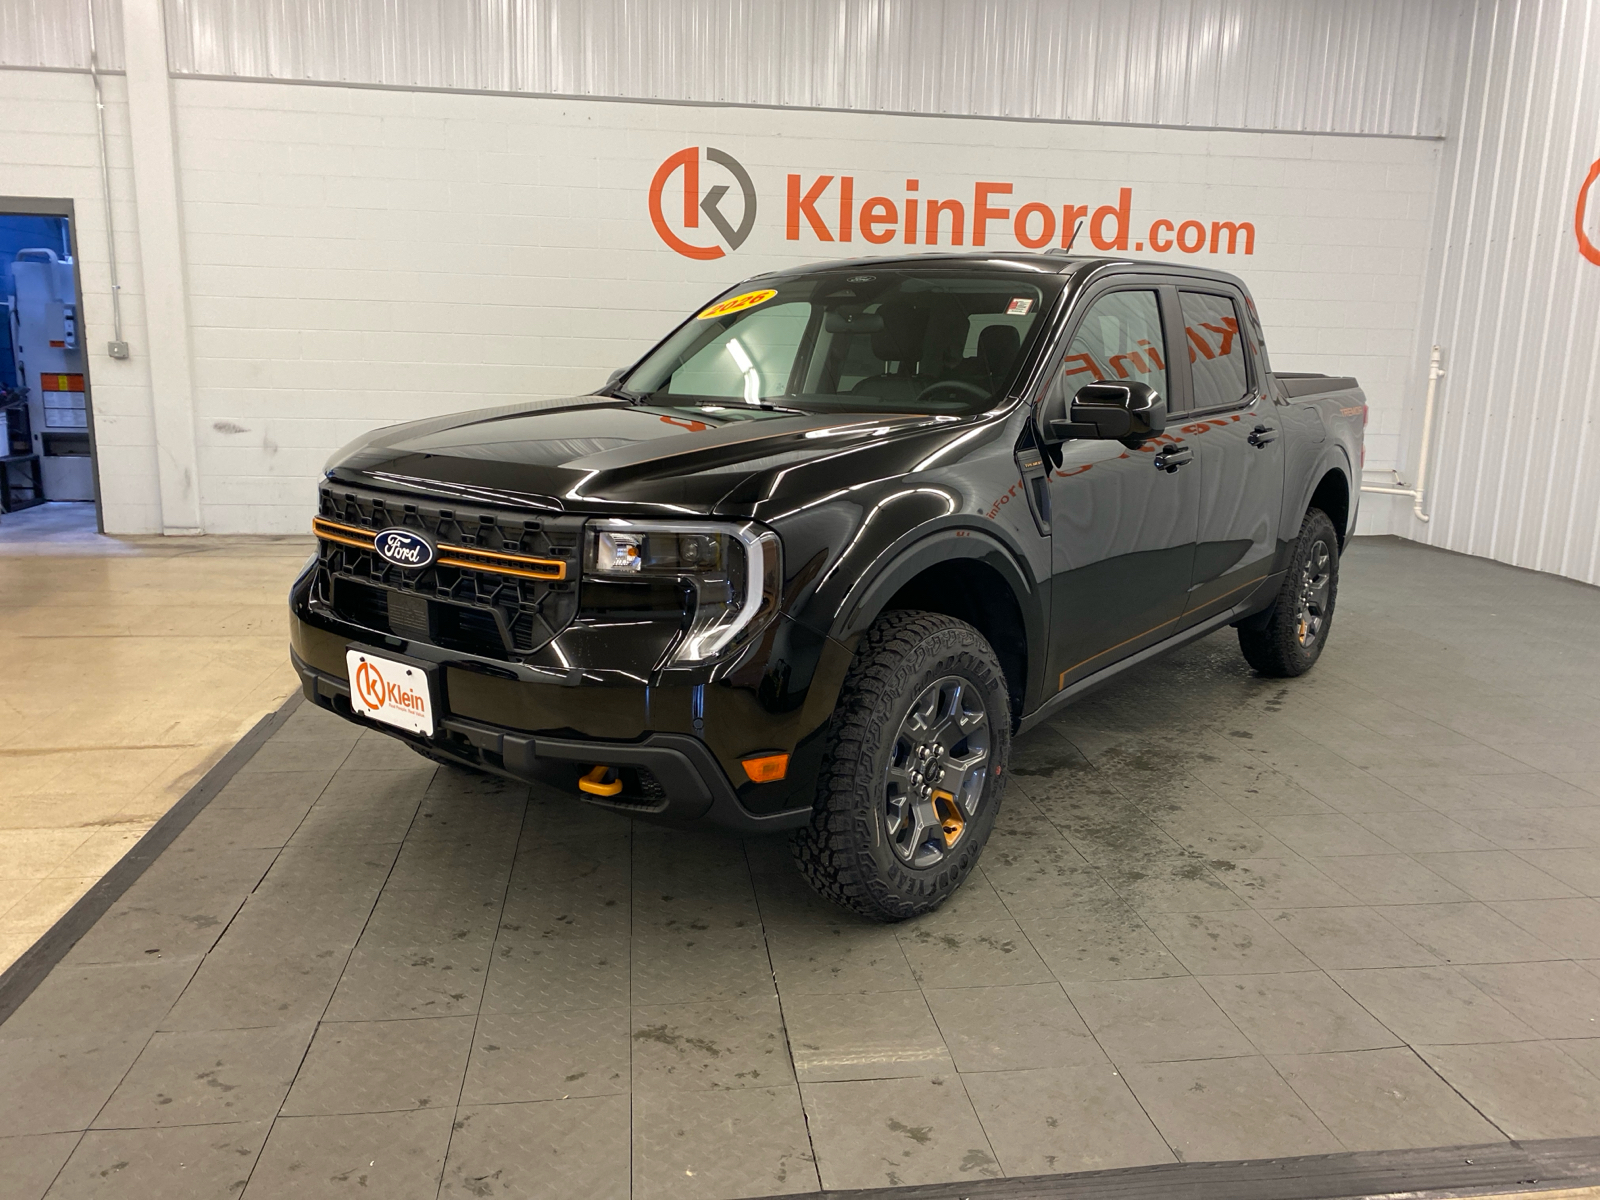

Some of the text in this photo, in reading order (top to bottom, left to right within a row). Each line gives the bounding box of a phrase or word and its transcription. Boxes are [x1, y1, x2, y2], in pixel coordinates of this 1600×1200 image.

[786, 174, 1254, 255] KleinFord.com
[703, 291, 770, 317] 2026
[384, 534, 421, 562] Ford
[386, 681, 425, 712] Klein
